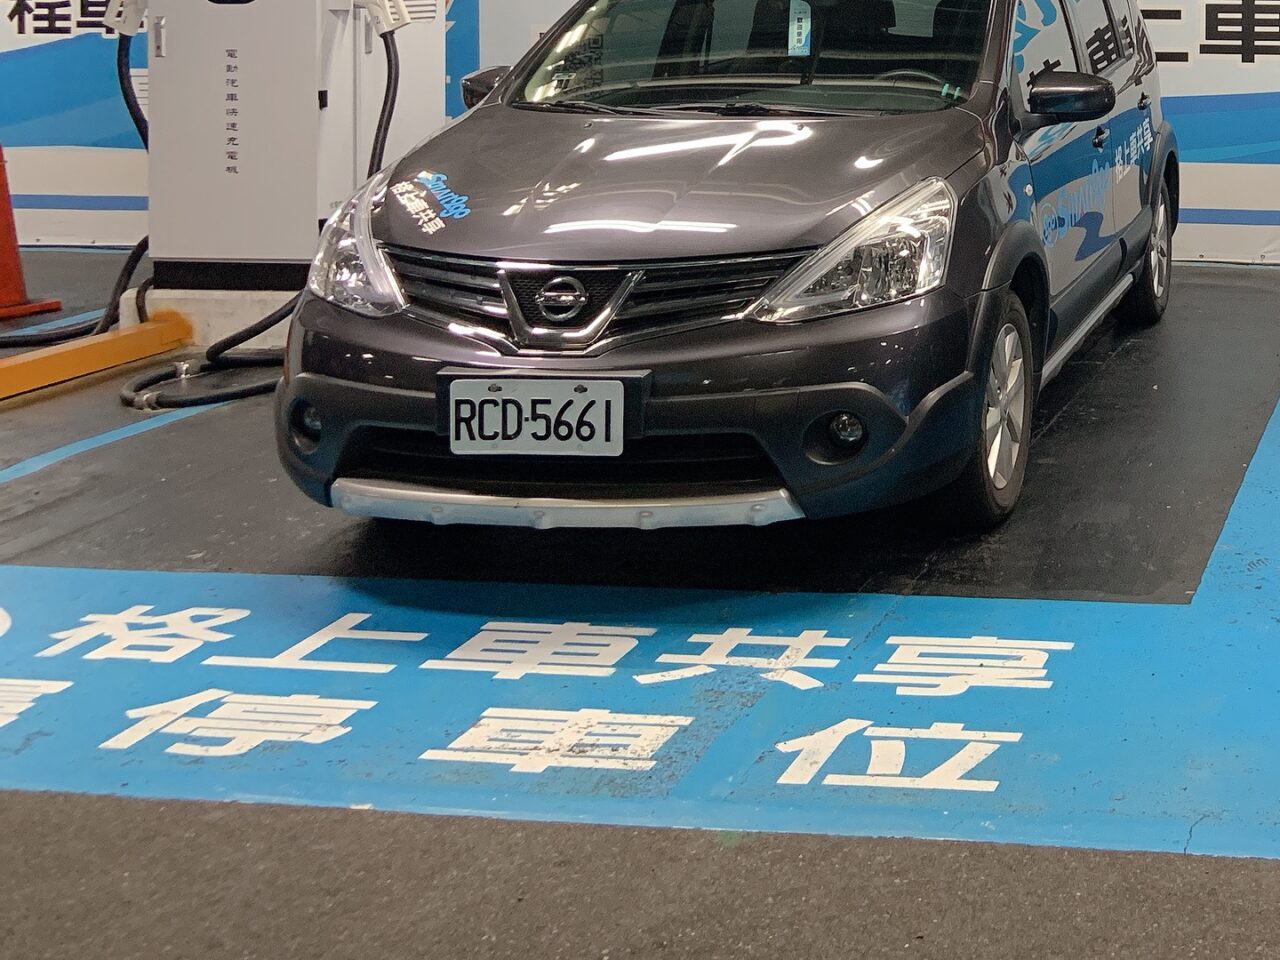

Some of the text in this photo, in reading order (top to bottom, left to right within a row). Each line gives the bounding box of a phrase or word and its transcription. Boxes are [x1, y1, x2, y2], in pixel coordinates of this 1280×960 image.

[454, 398, 612, 442] RCD-5661
[35, 604, 1075, 697] 格上車共享
[0, 678, 1023, 792] 停車位
